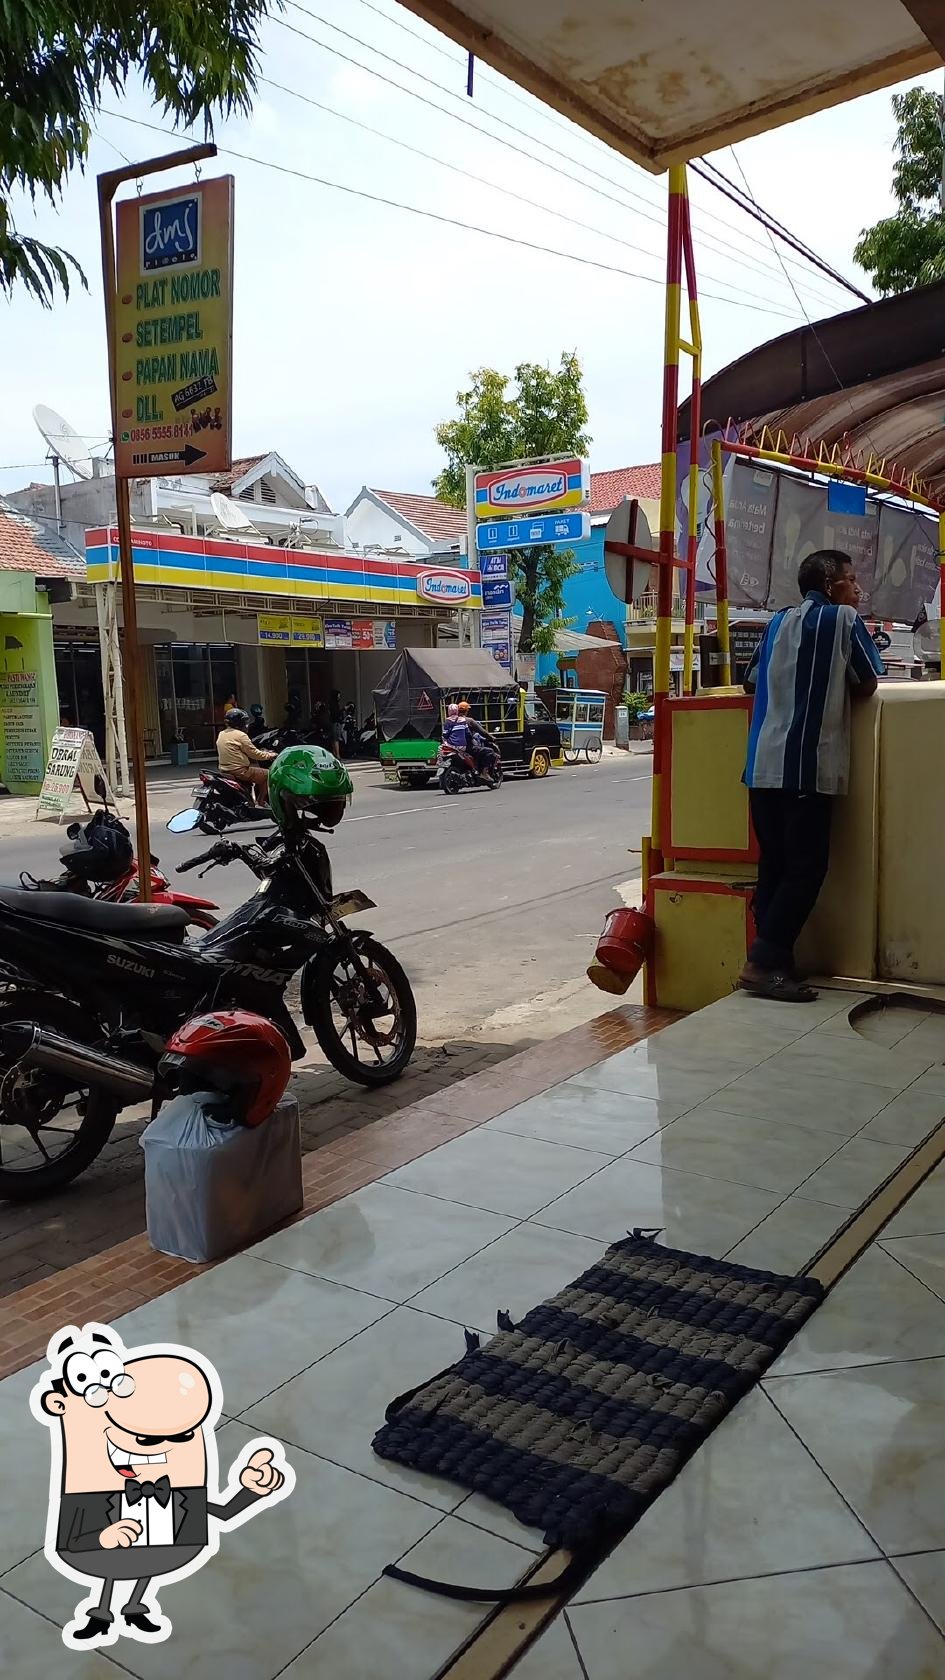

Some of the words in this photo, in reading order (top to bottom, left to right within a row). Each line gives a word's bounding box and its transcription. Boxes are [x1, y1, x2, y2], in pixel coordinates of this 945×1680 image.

[136, 278, 167, 310] PLAT
[170, 269, 221, 304] NOMOR
[136, 311, 203, 347] SETEMPEL
[136, 354, 177, 386] PAPAN
[180, 347, 220, 380] NAMA
[151, 452, 180, 462] MASUK
[493, 476, 564, 501] Indomaret
[425, 578, 467, 594] Indomaret
[51, 747, 78, 762] OBRAL
[46, 763, 76, 778] SARUNG
[106, 954, 156, 978] SUZUKI
